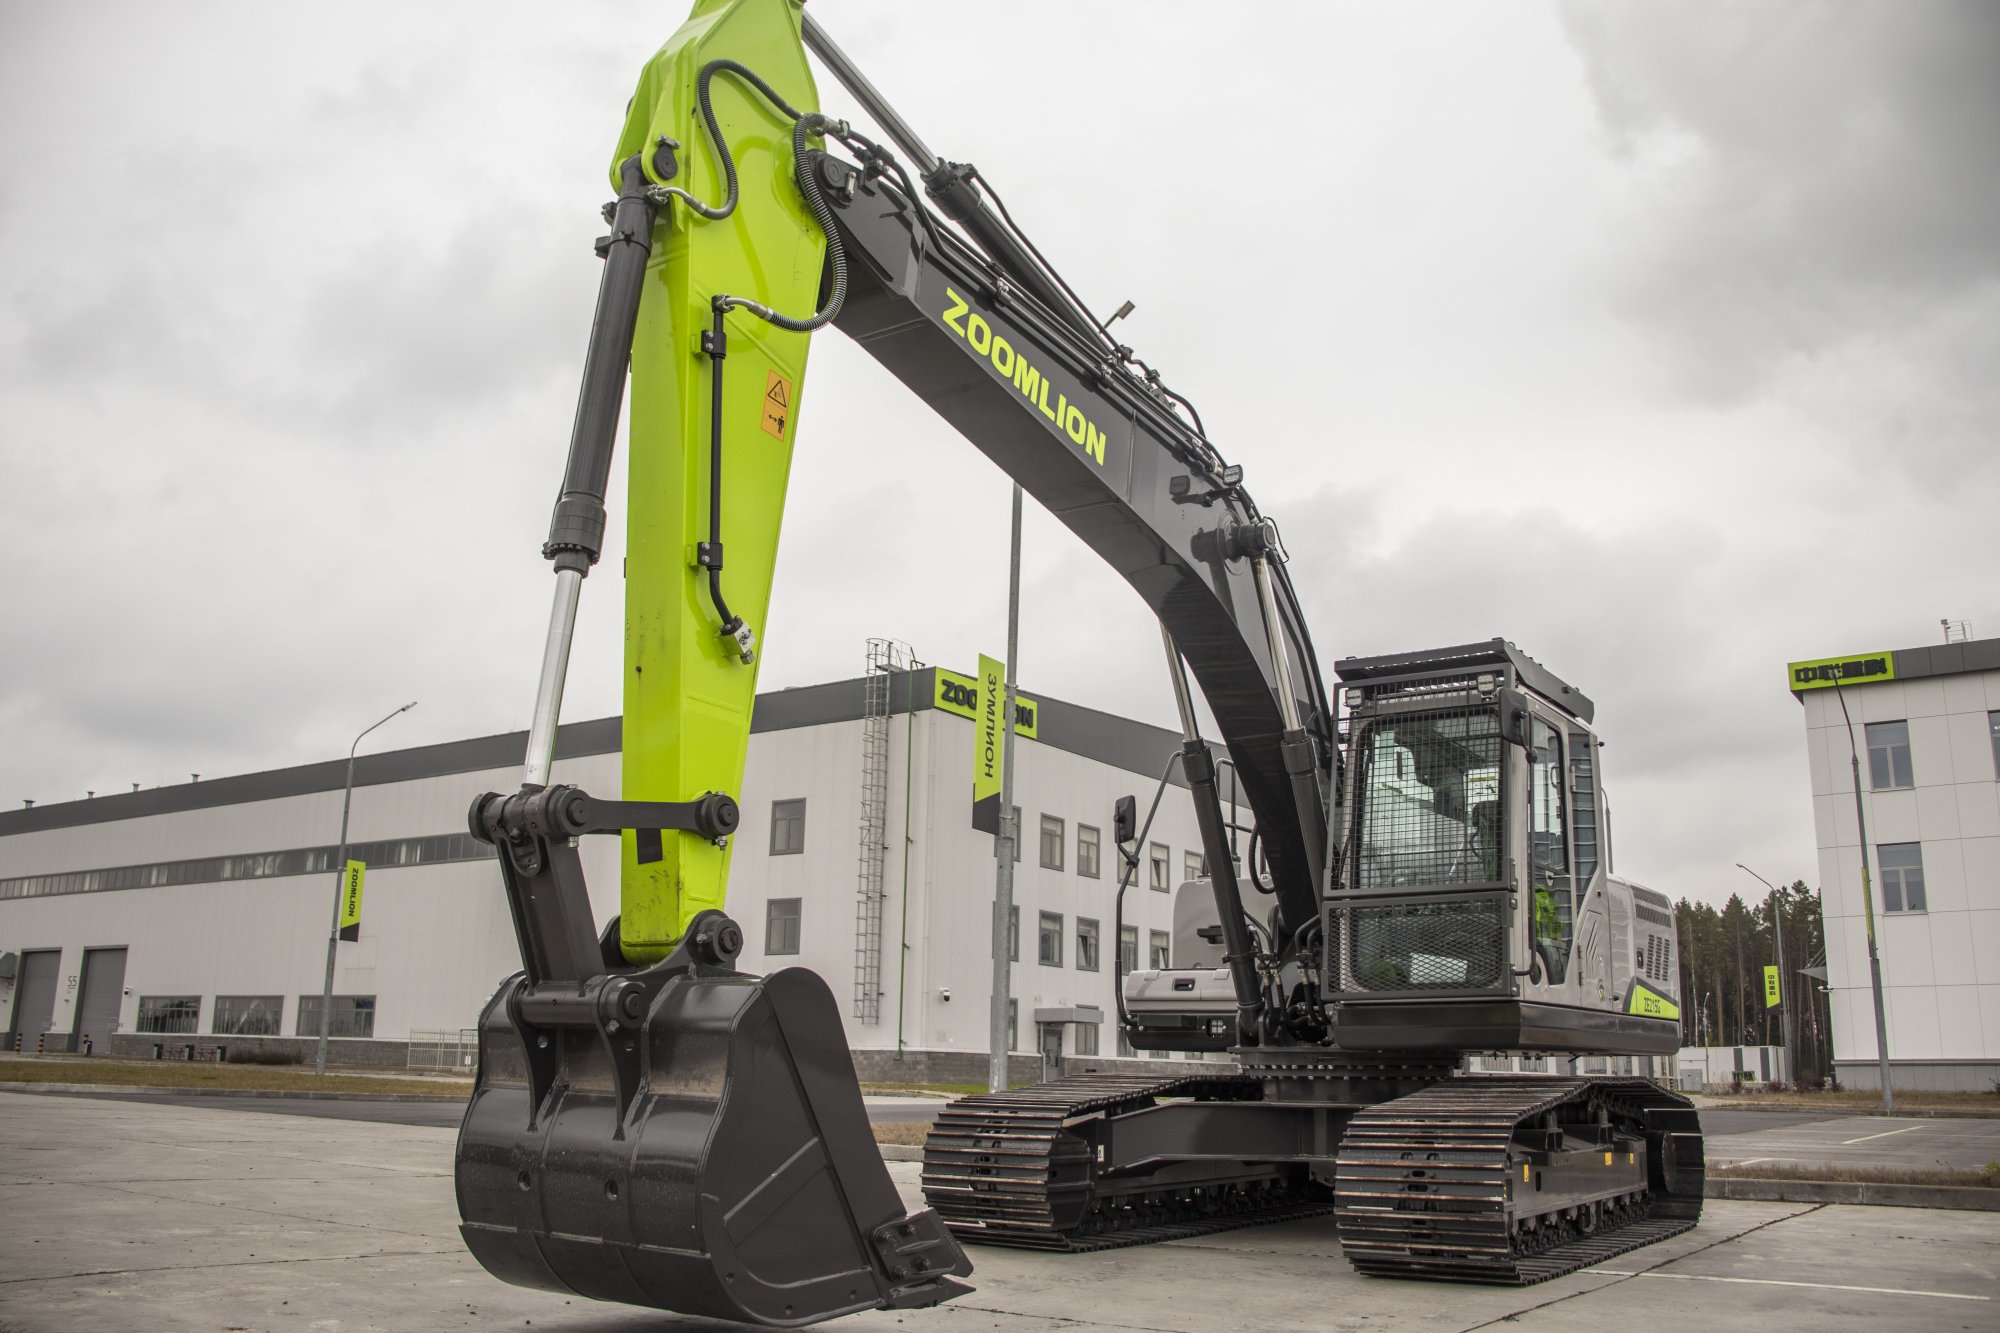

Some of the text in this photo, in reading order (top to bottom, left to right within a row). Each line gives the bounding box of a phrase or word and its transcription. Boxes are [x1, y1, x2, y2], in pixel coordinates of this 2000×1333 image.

[942, 287, 1107, 466] ZOOMLION
[984, 673, 997, 778] ЗУМЛИОН
[348, 867, 359, 917] ZOOMLION
